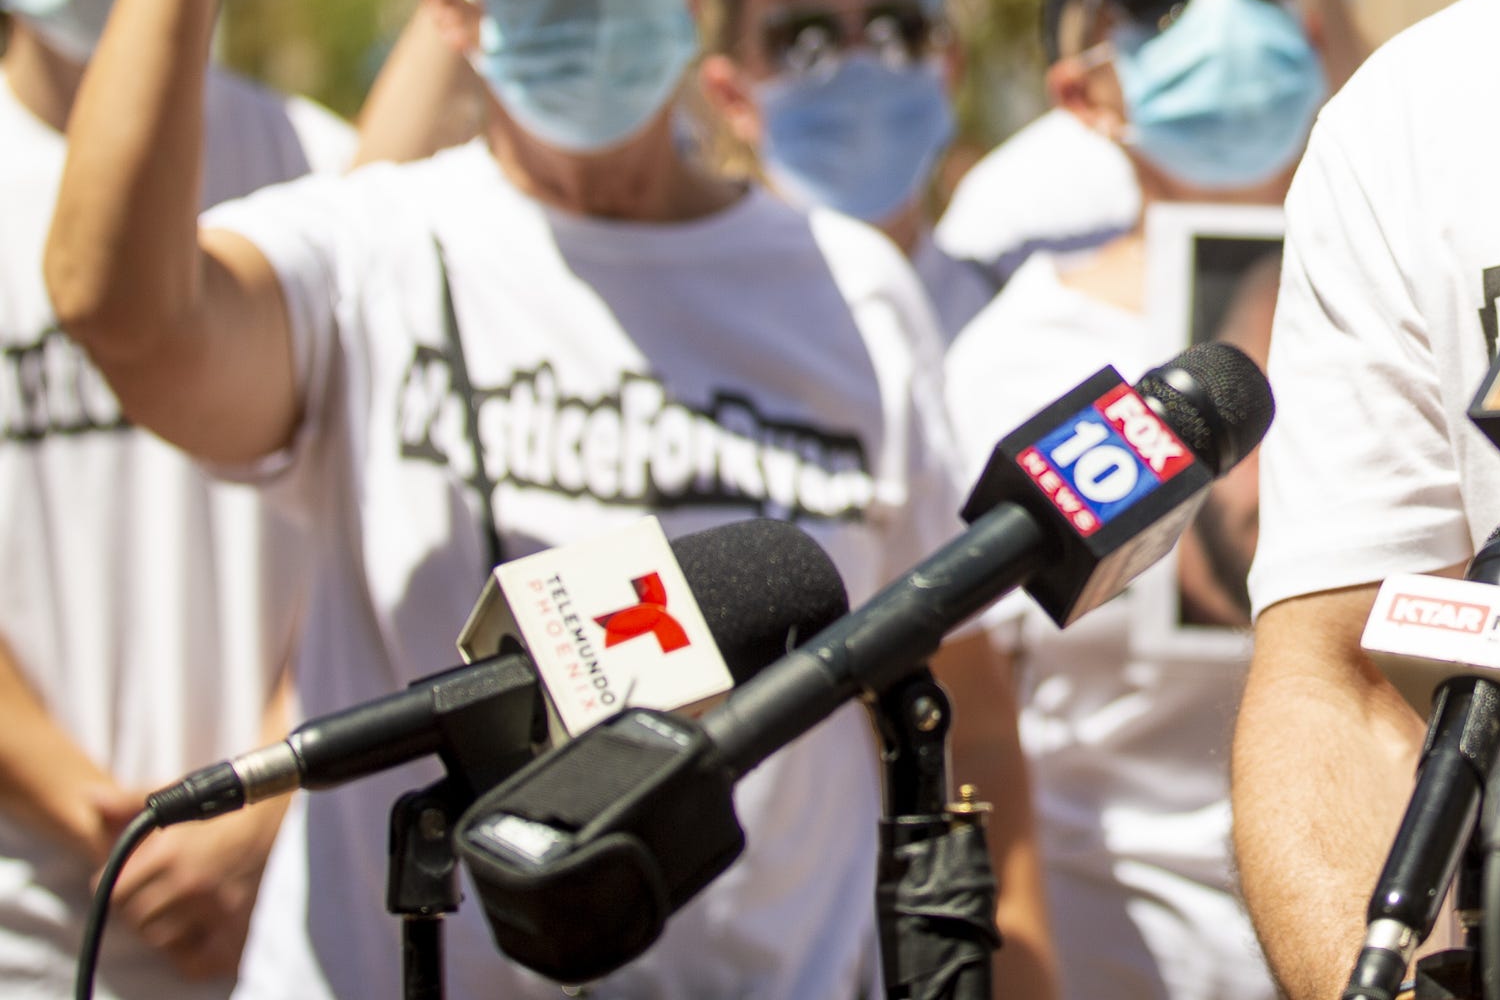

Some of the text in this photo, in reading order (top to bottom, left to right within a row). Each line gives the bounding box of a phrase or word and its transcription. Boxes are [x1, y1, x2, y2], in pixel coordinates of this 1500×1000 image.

[1050, 420, 1139, 503] 10
[1104, 392, 1184, 474] FOX
[1022, 450, 1097, 531] NEWS
[526, 578, 598, 712] PHOENIX
[546, 574, 616, 706] TELEMUNDO
[1390, 596, 1484, 632] KTAR
